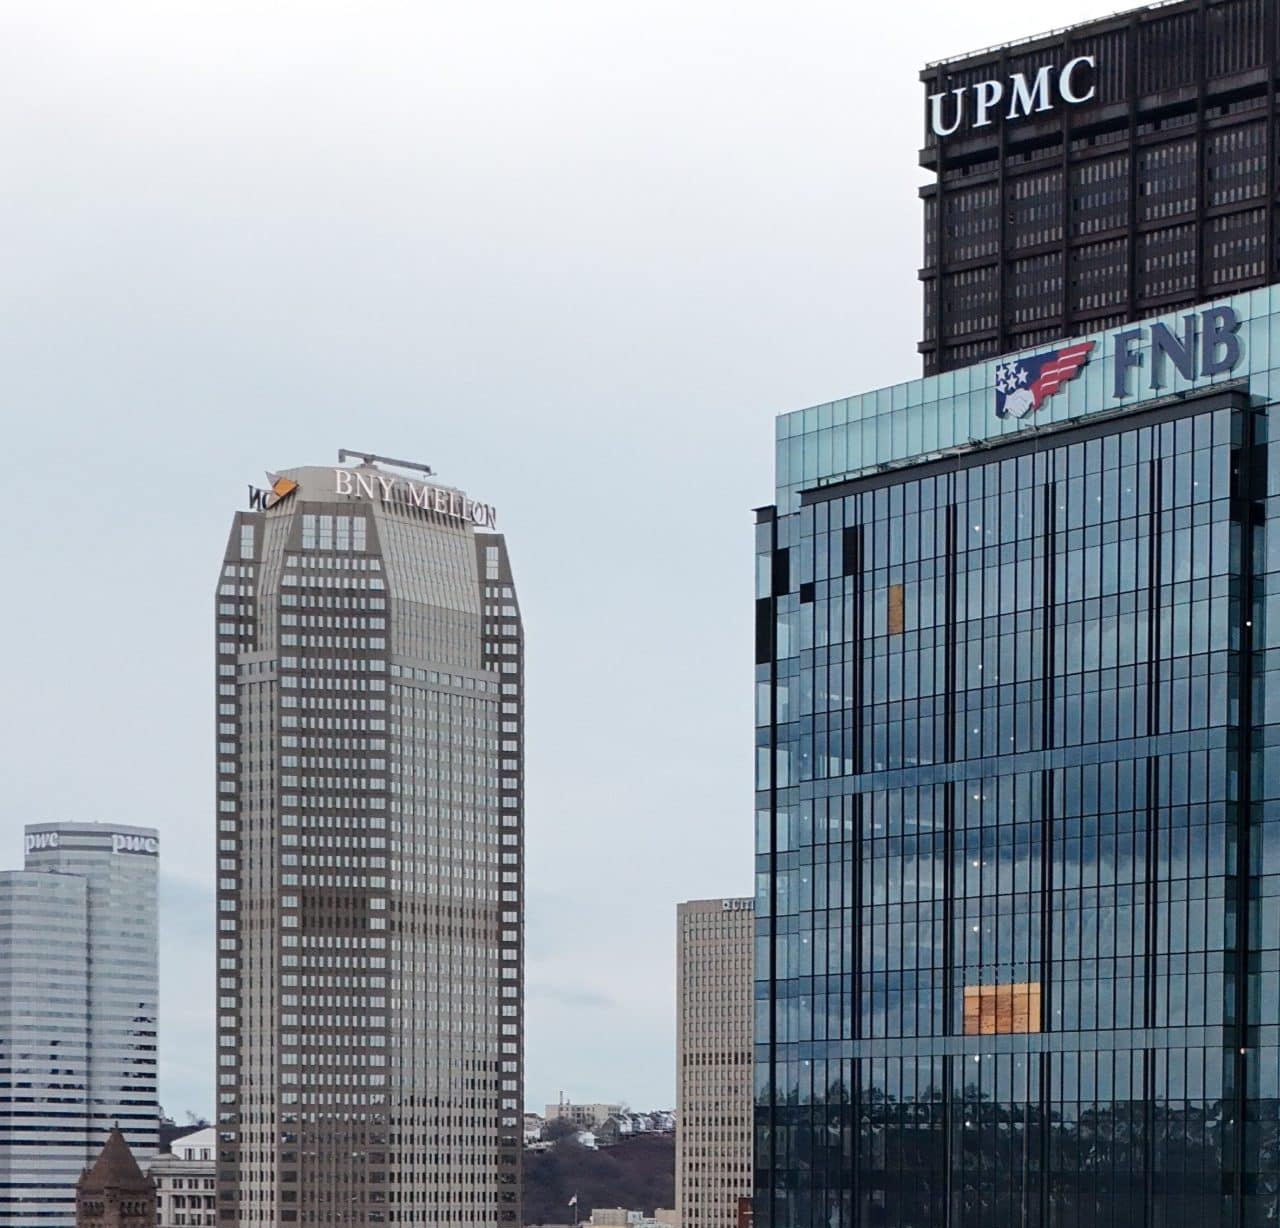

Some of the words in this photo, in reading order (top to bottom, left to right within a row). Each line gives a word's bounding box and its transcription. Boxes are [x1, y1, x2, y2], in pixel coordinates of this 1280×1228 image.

[928, 55, 1097, 137] UPMC
[1113, 306, 1243, 398] FNB
[335, 469, 395, 502] BNY
[407, 482, 497, 531] MELLON
[25, 832, 59, 854] pwc
[111, 833, 158, 855] pwc
